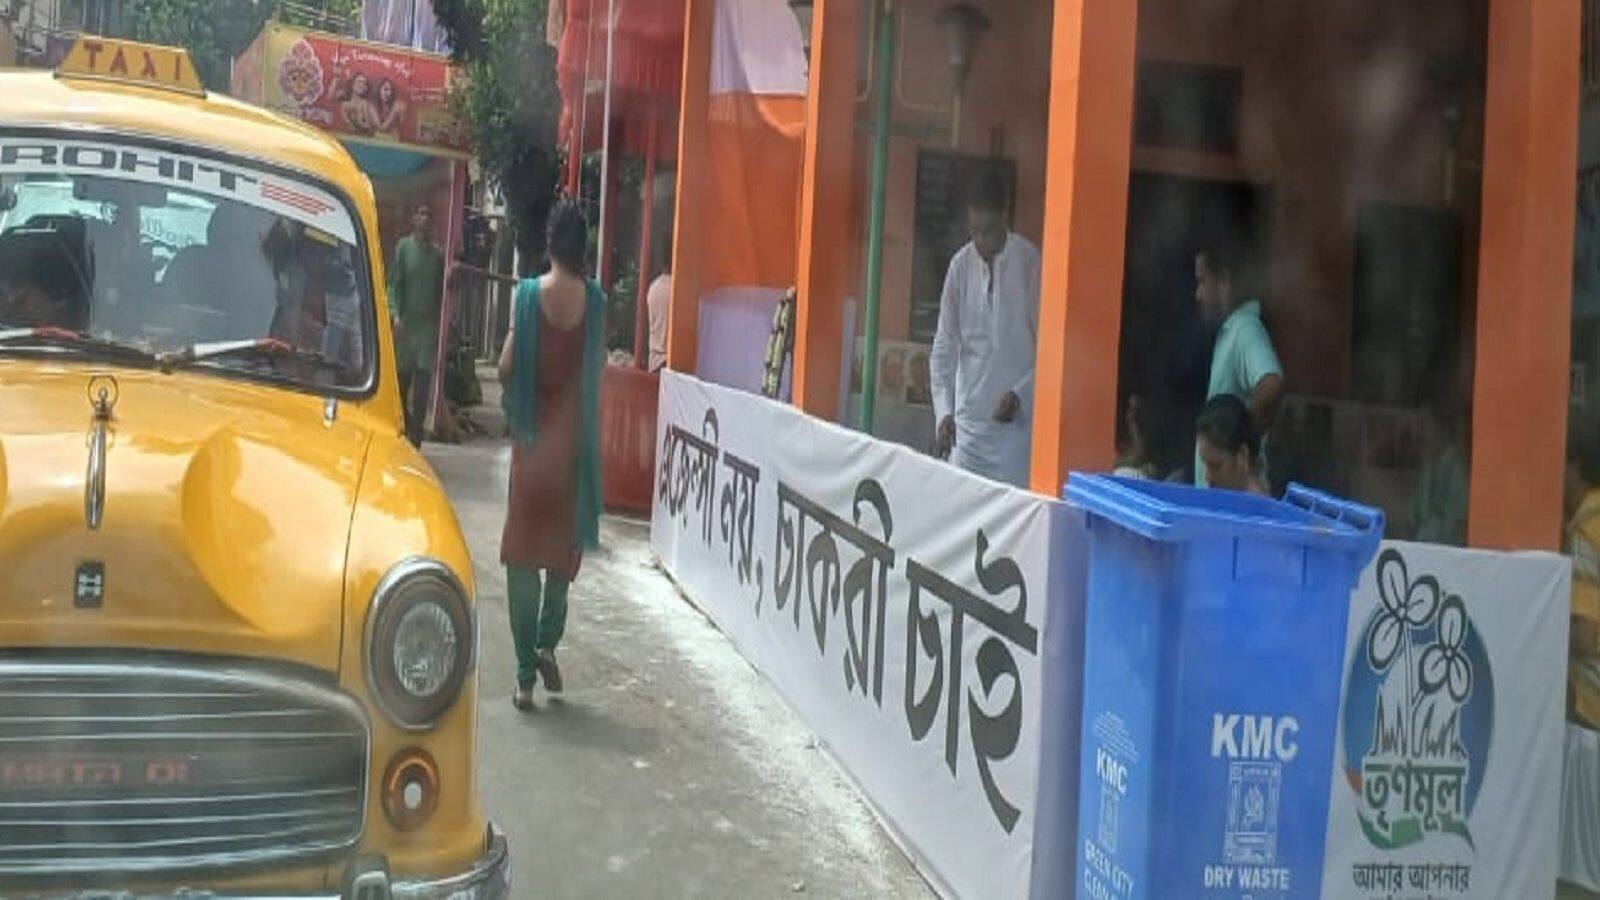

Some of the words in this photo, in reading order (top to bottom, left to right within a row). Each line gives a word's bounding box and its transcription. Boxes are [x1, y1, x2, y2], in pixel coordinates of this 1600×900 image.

[83, 40, 182, 81] TAXI
[0, 144, 258, 191] ROHIT
[774, 478, 895, 707] চাকরী
[904, 528, 1038, 835] চাই
[1210, 713, 1300, 761] KMC
[1095, 748, 1129, 795] KMC
[1363, 758, 1466, 833] তৃণমূল
[1203, 865, 1234, 889] DRY
[1237, 867, 1291, 891] WASTE
[1352, 862, 1403, 893] আমার
